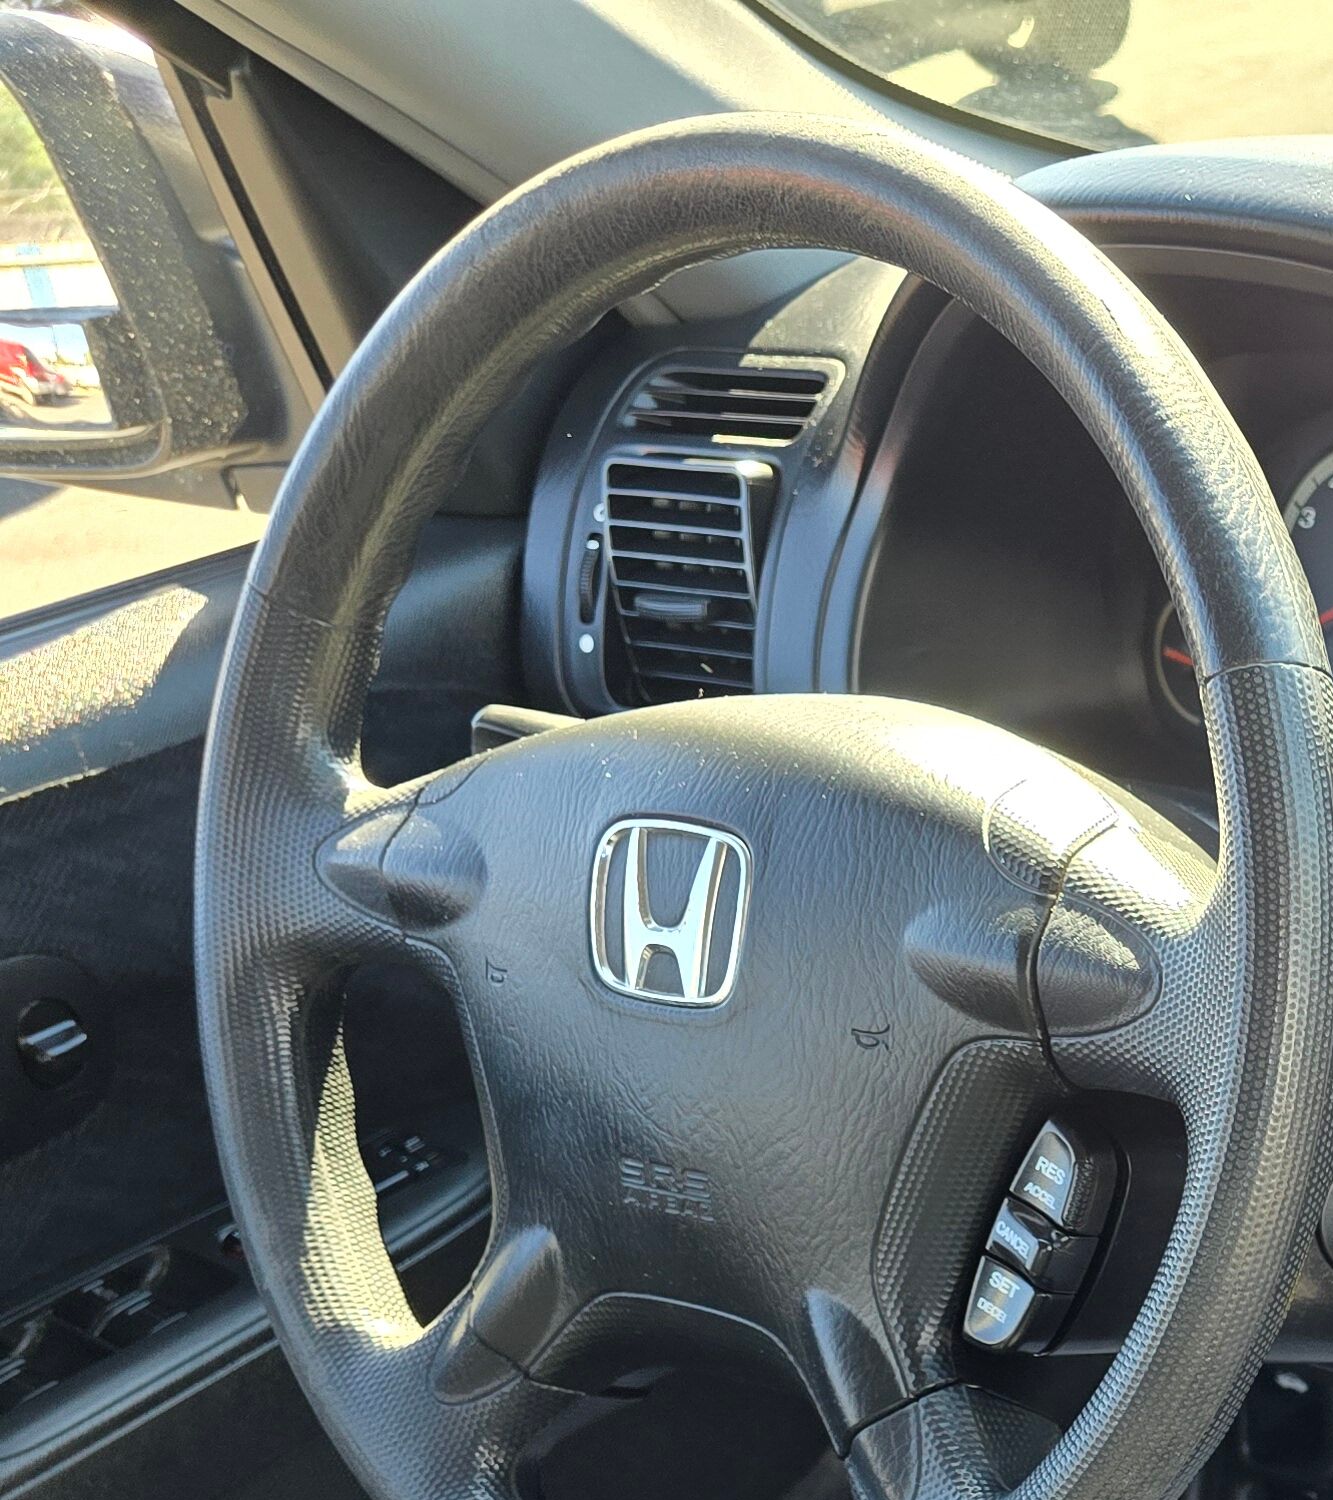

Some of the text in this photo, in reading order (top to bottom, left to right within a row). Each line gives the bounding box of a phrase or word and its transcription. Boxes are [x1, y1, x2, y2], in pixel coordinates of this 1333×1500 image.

[1298, 506, 1316, 529] 3
[1035, 1156, 1066, 1185] RES
[1023, 1182, 1056, 1210] ACCEL
[995, 1221, 1030, 1259] CANCEL
[989, 1271, 1021, 1298] SET
[977, 1297, 1007, 1324] DECEL
